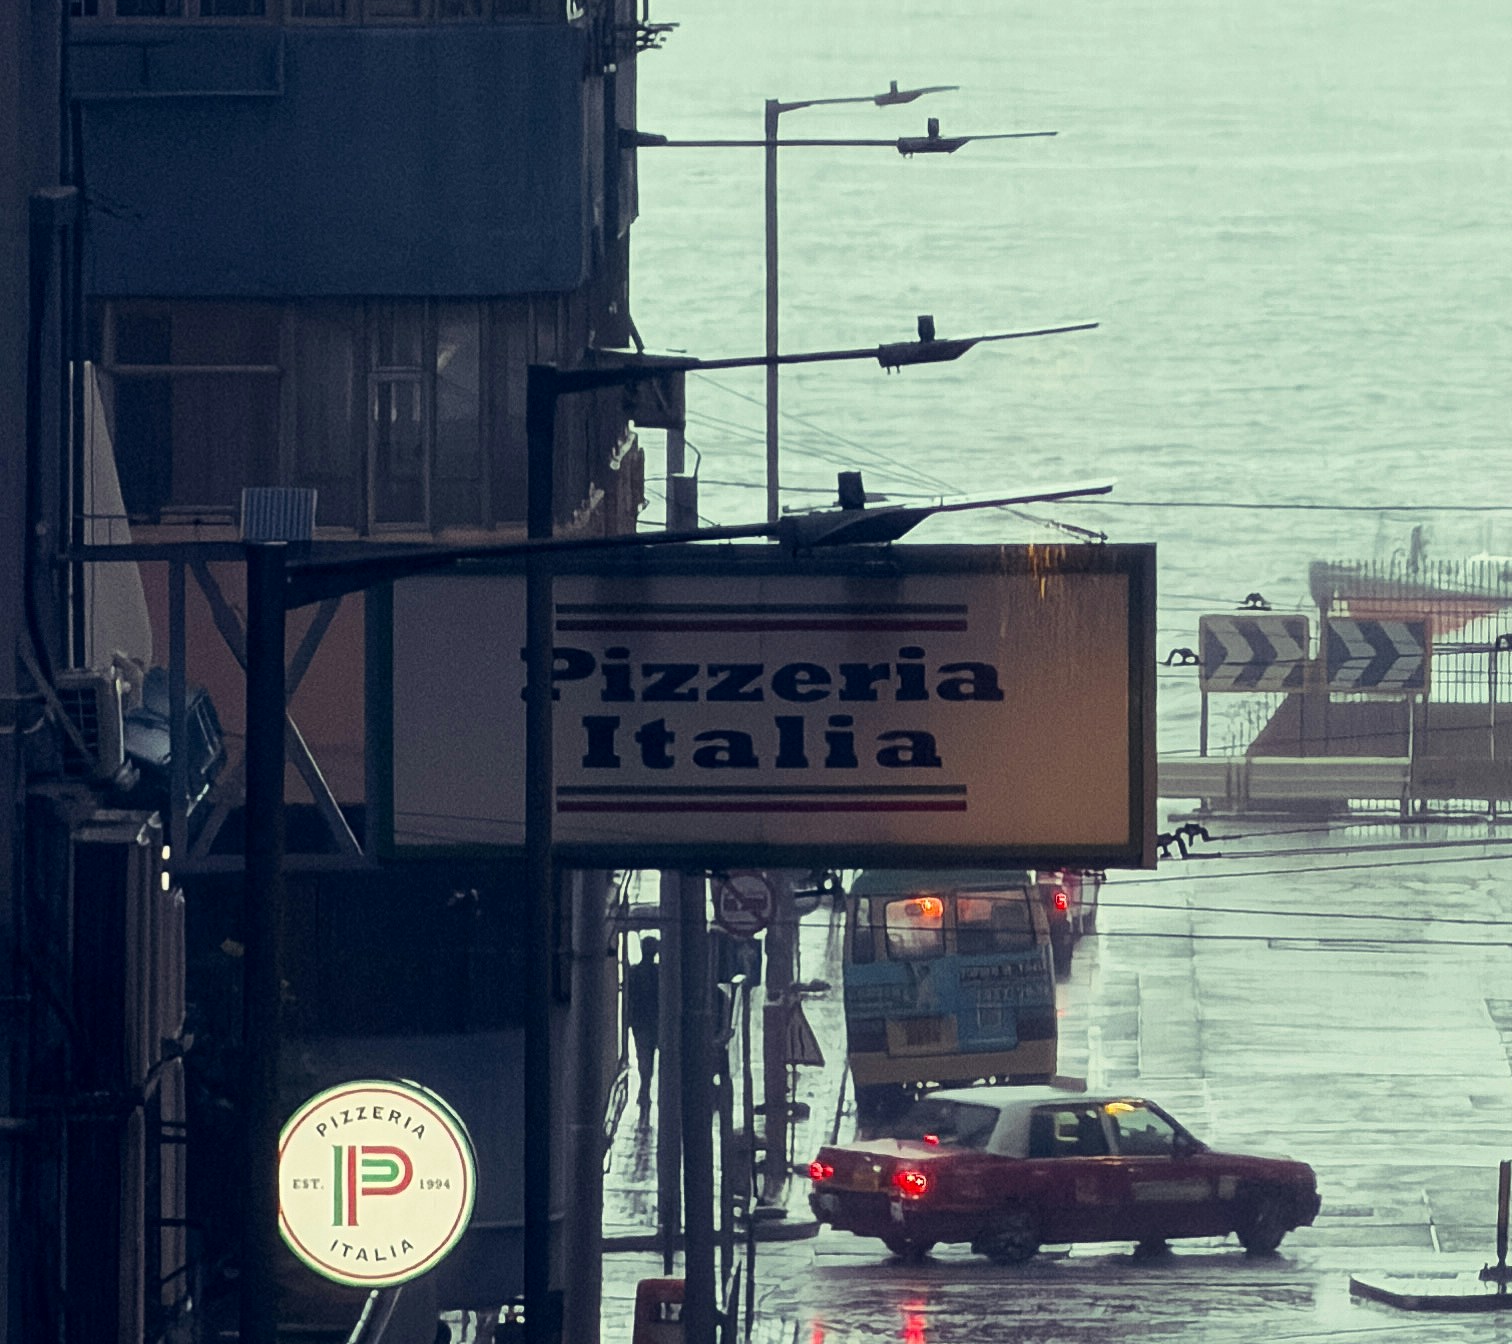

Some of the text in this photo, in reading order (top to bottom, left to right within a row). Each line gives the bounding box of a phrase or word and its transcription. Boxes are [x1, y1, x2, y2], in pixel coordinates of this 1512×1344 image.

[521, 646, 1004, 702] Pizzeria
[581, 715, 942, 769] Italia
[316, 1106, 425, 1139] PIZZERIA
[292, 1178, 324, 1190] EST.
[419, 1178, 451, 1190] 1994
[330, 1239, 414, 1261] ITALIA
